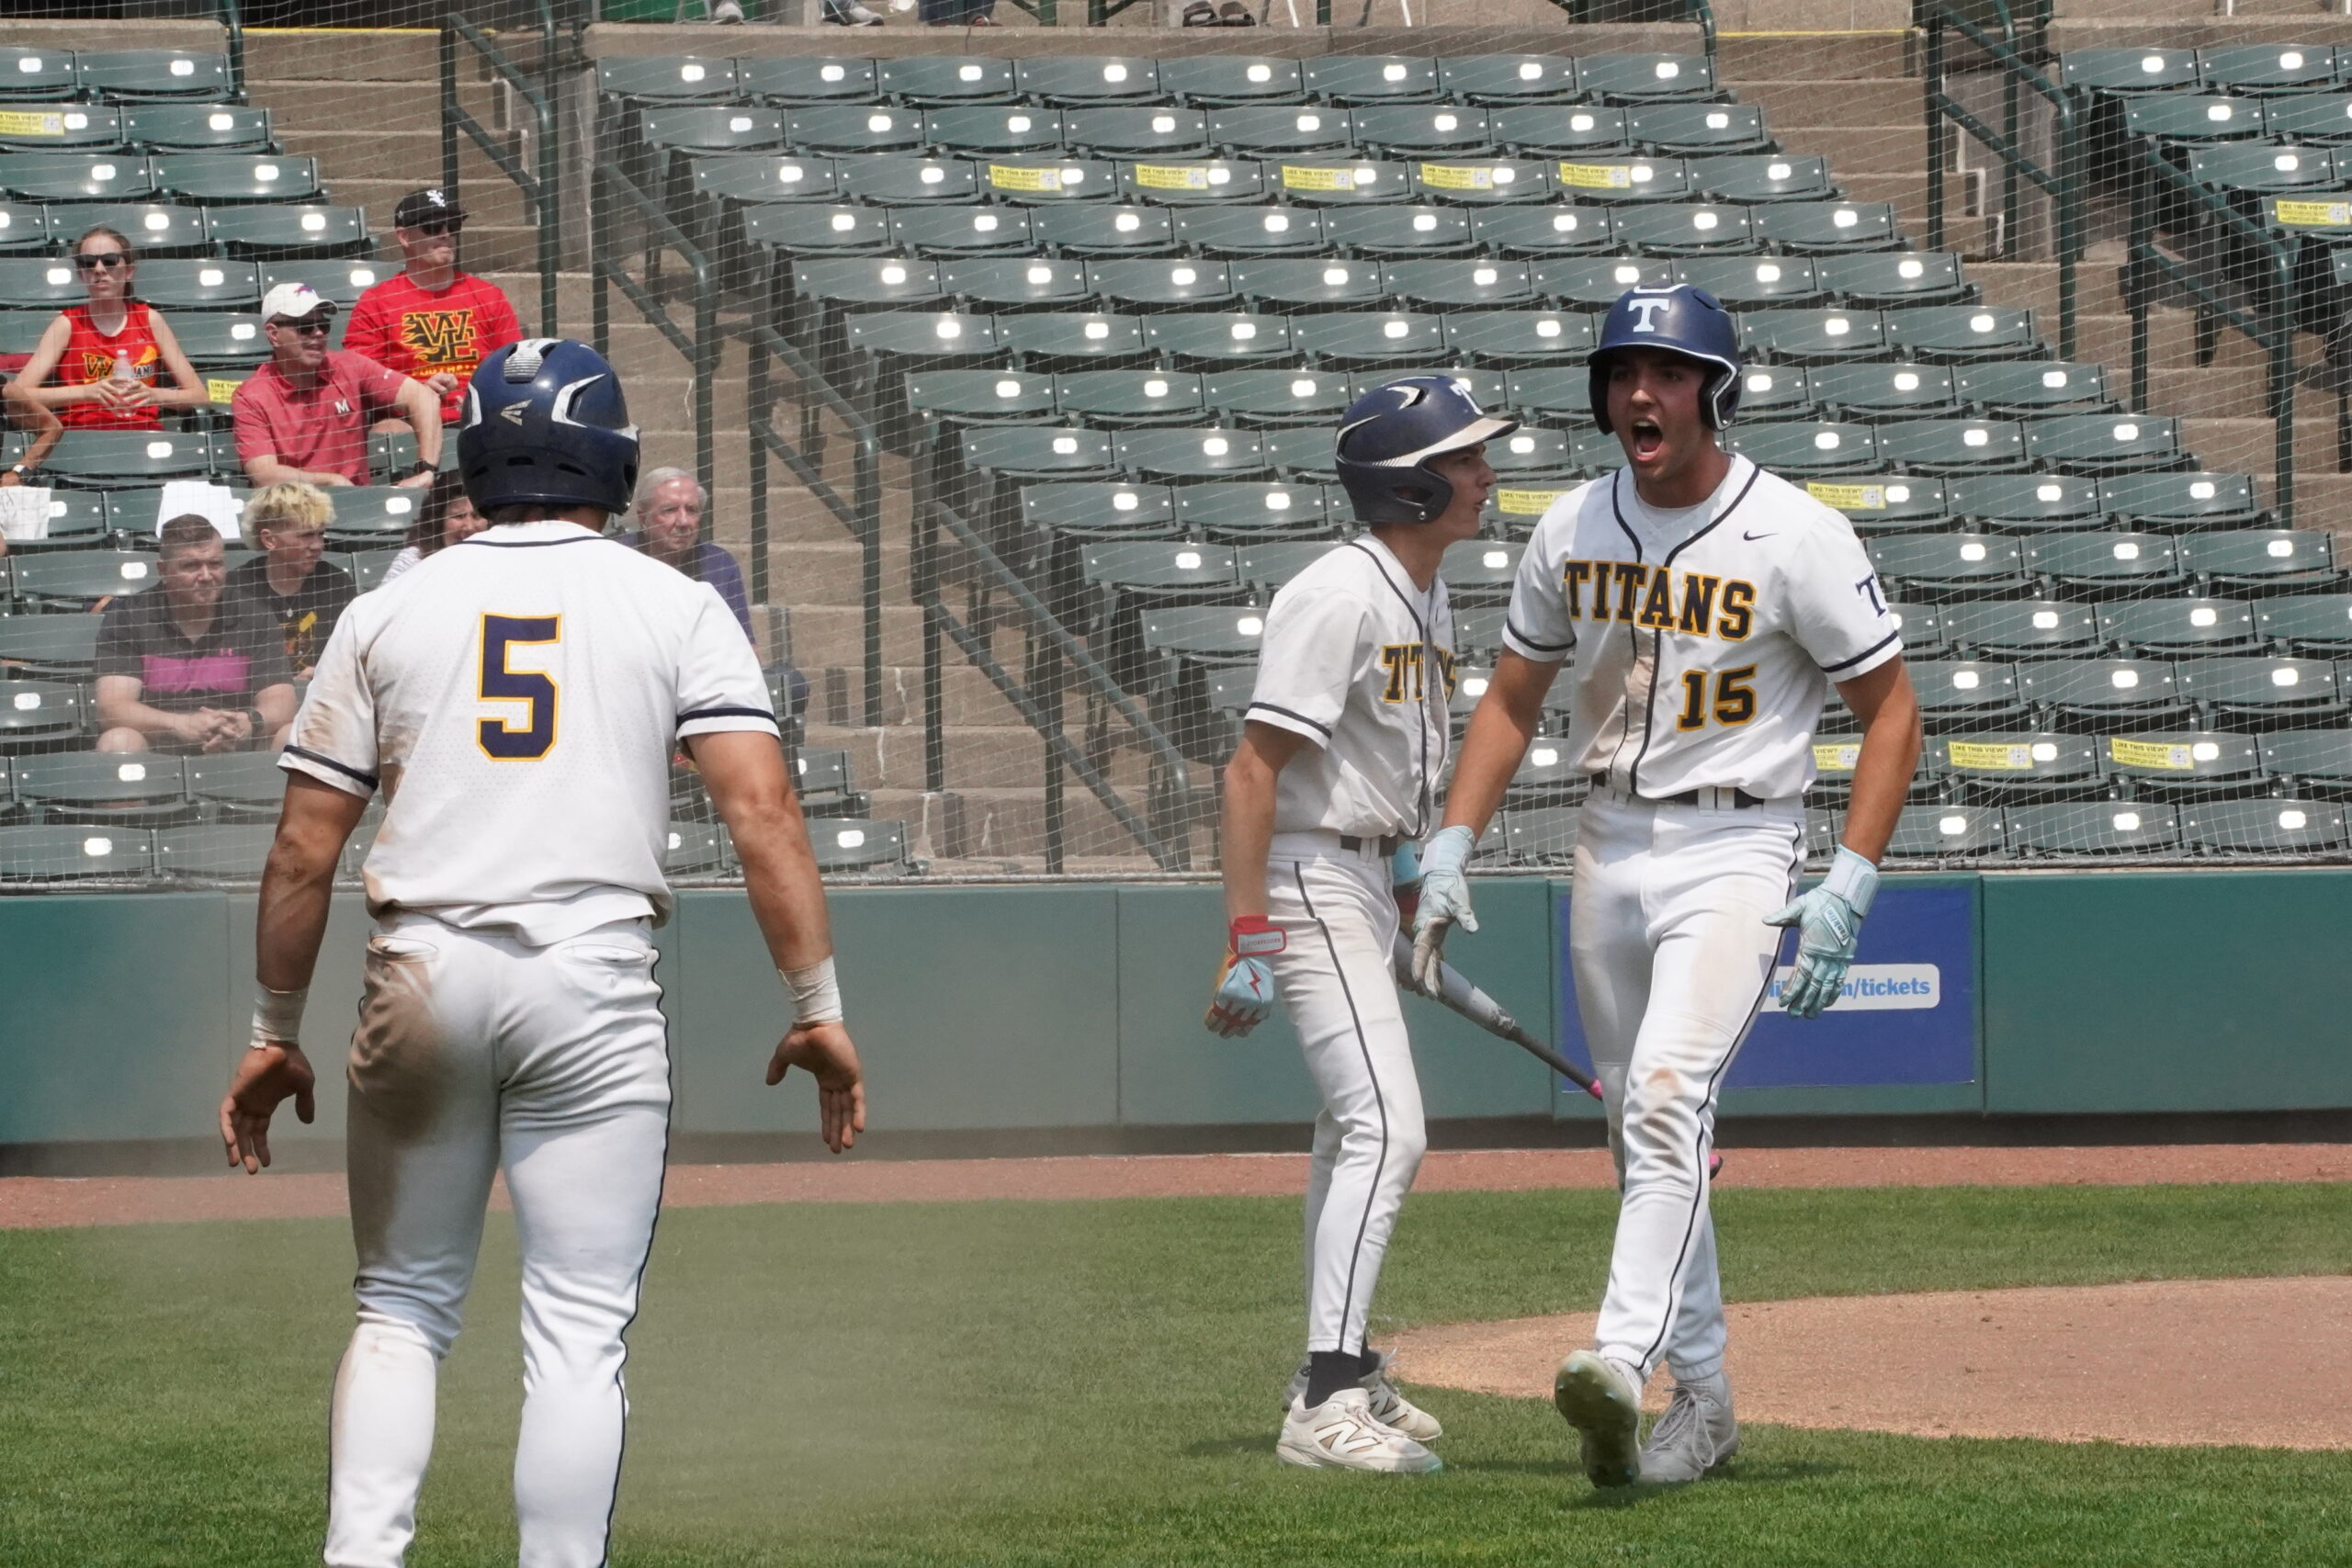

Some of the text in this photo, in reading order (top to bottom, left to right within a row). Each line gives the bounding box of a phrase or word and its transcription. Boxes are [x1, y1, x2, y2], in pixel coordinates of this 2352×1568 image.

[1627, 298, 1669, 333] T
[334, 398, 350, 414] M
[1563, 559, 1757, 642] TITANS
[1855, 570, 1887, 618] T
[476, 611, 562, 761] 5
[1677, 663, 1758, 732] 15
[2114, 741, 2128, 750] LIKE
[2131, 744, 2144, 752] THIS
